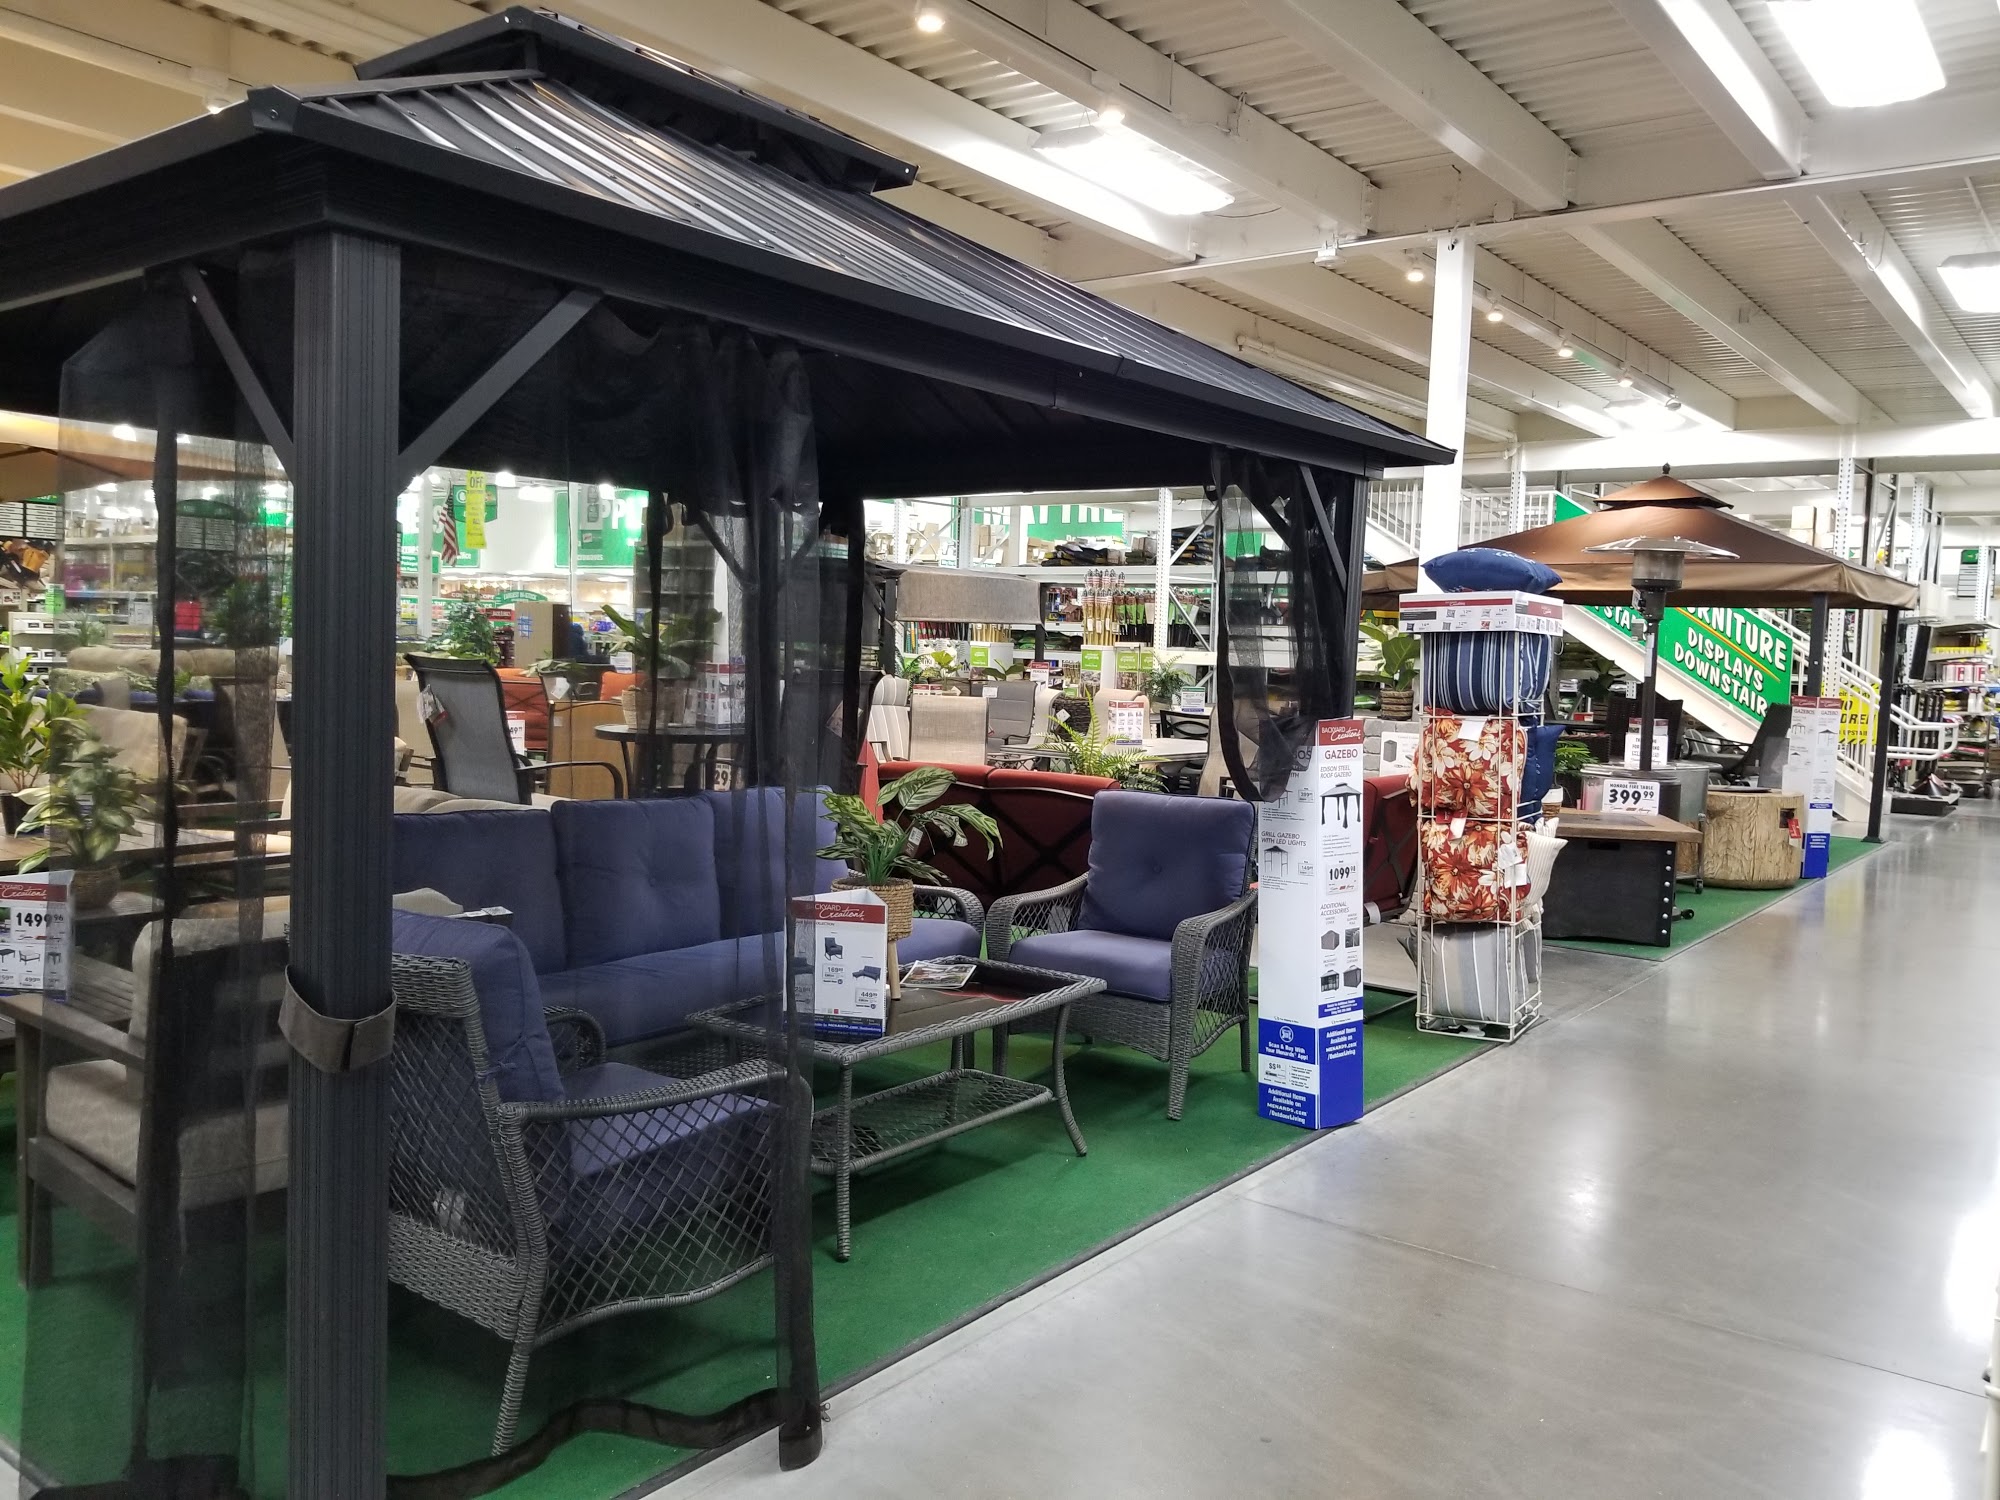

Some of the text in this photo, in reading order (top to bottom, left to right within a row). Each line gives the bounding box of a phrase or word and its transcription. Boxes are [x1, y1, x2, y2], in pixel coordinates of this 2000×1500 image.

[1688, 626, 1764, 692] DISPLAYS
[1674, 642, 1768, 718] DOWNSTAIR
[1321, 726, 1345, 734] BACKYARD
[1331, 727, 1361, 741] Creations
[1324, 748, 1358, 760] GAZEBO
[1608, 789, 1654, 805] 399 99
[1329, 866, 1350, 880] 1099
[1320, 901, 1347, 910] ADDITIONAL
[1320, 907, 1349, 916] ACCESSORIES
[819, 906, 865, 919] Creations
[16, 912, 51, 927] 1499
[1326, 1029, 1345, 1038] Additional
[1268, 1041, 1279, 1049] Scan
[1285, 1044, 1294, 1052] Buy
[1268, 1088, 1306, 1101] Additional Items
[1273, 1096, 1294, 1106] Available
